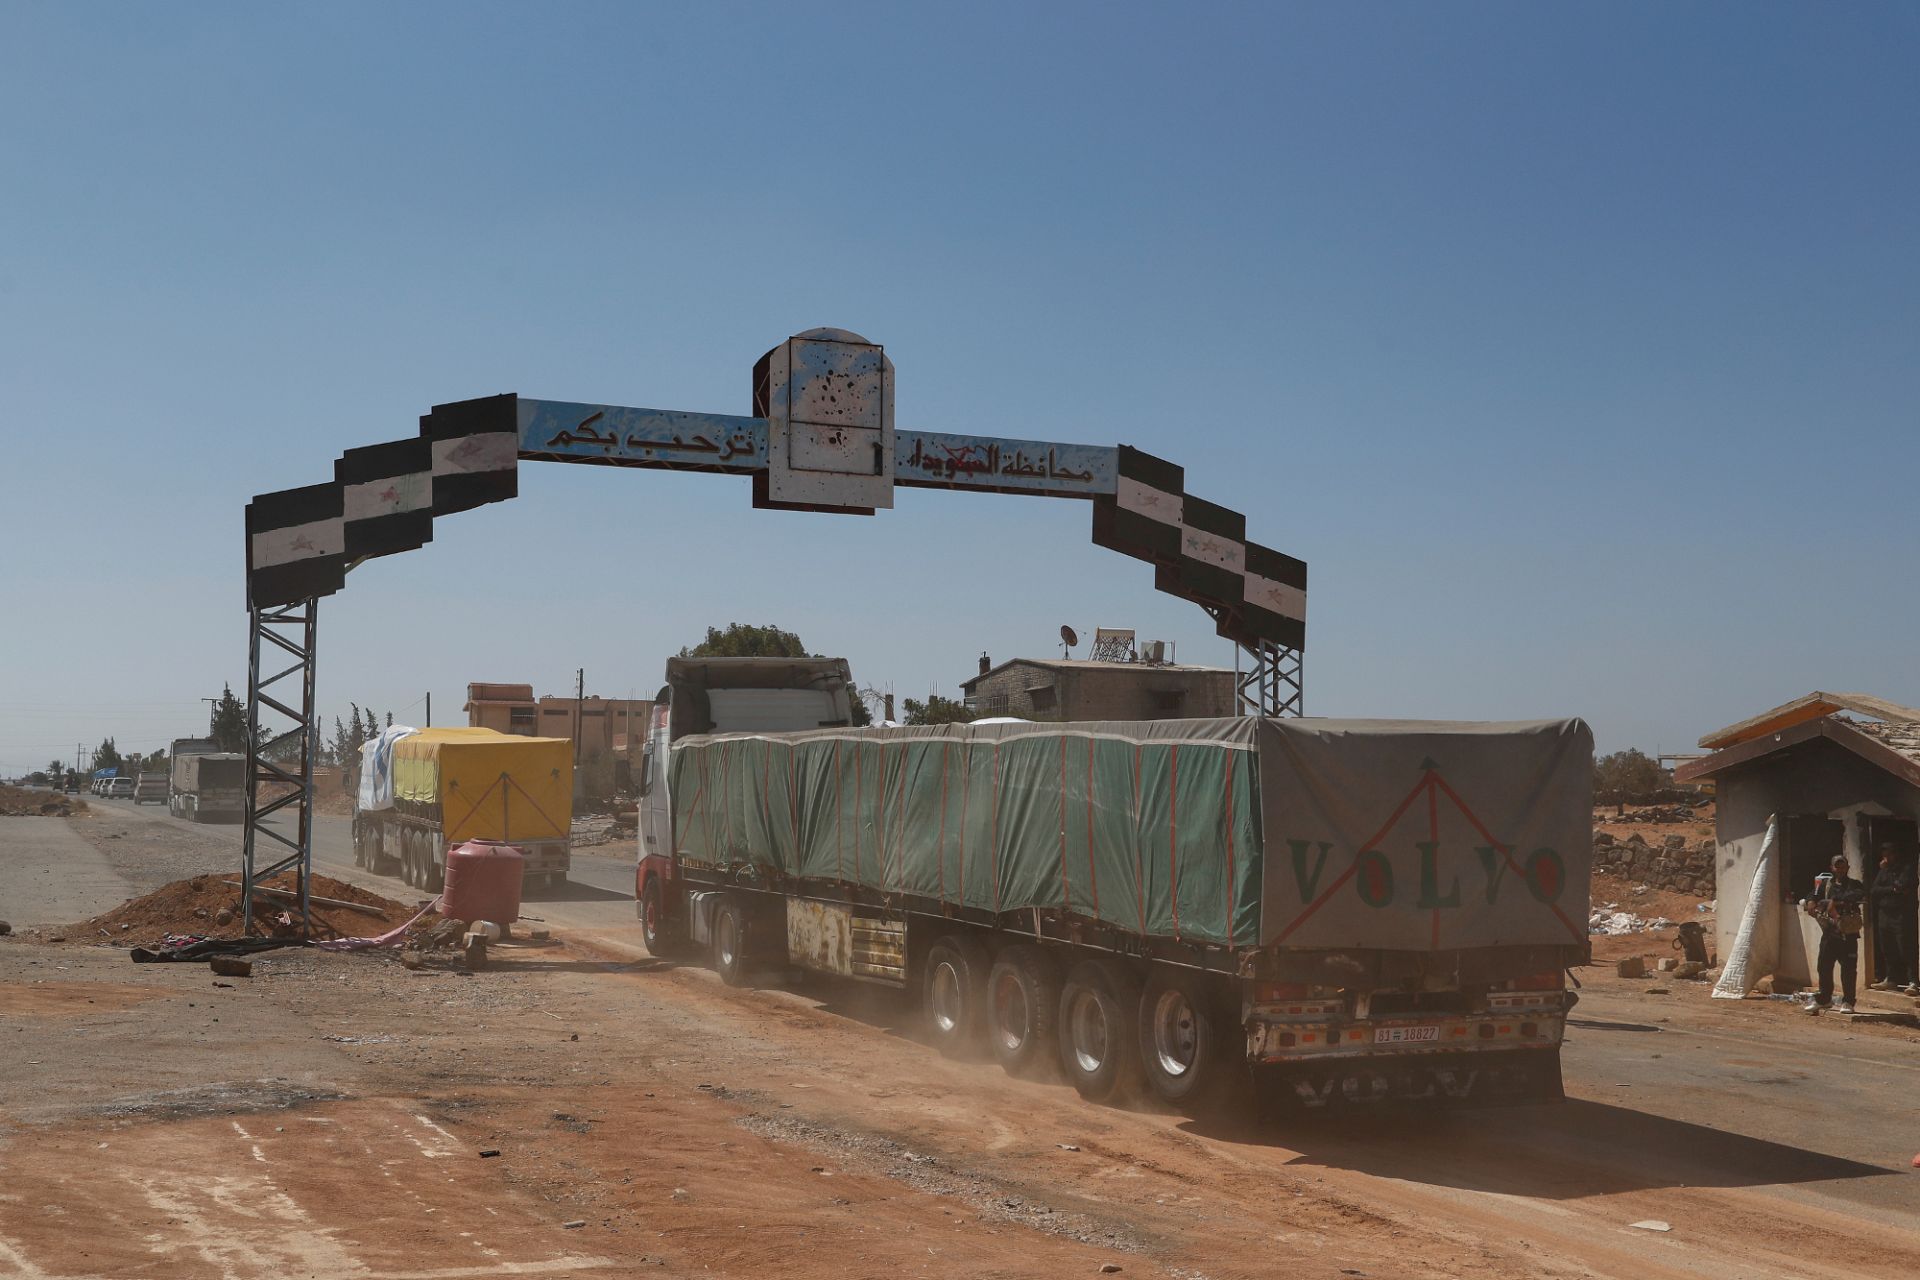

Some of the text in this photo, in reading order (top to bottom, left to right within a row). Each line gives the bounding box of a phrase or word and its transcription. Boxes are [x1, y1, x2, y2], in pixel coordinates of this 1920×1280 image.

[547, 411, 619, 452] بكم
[1001, 446, 1094, 483] محافظة
[1286, 838, 1566, 909] VOLVO
